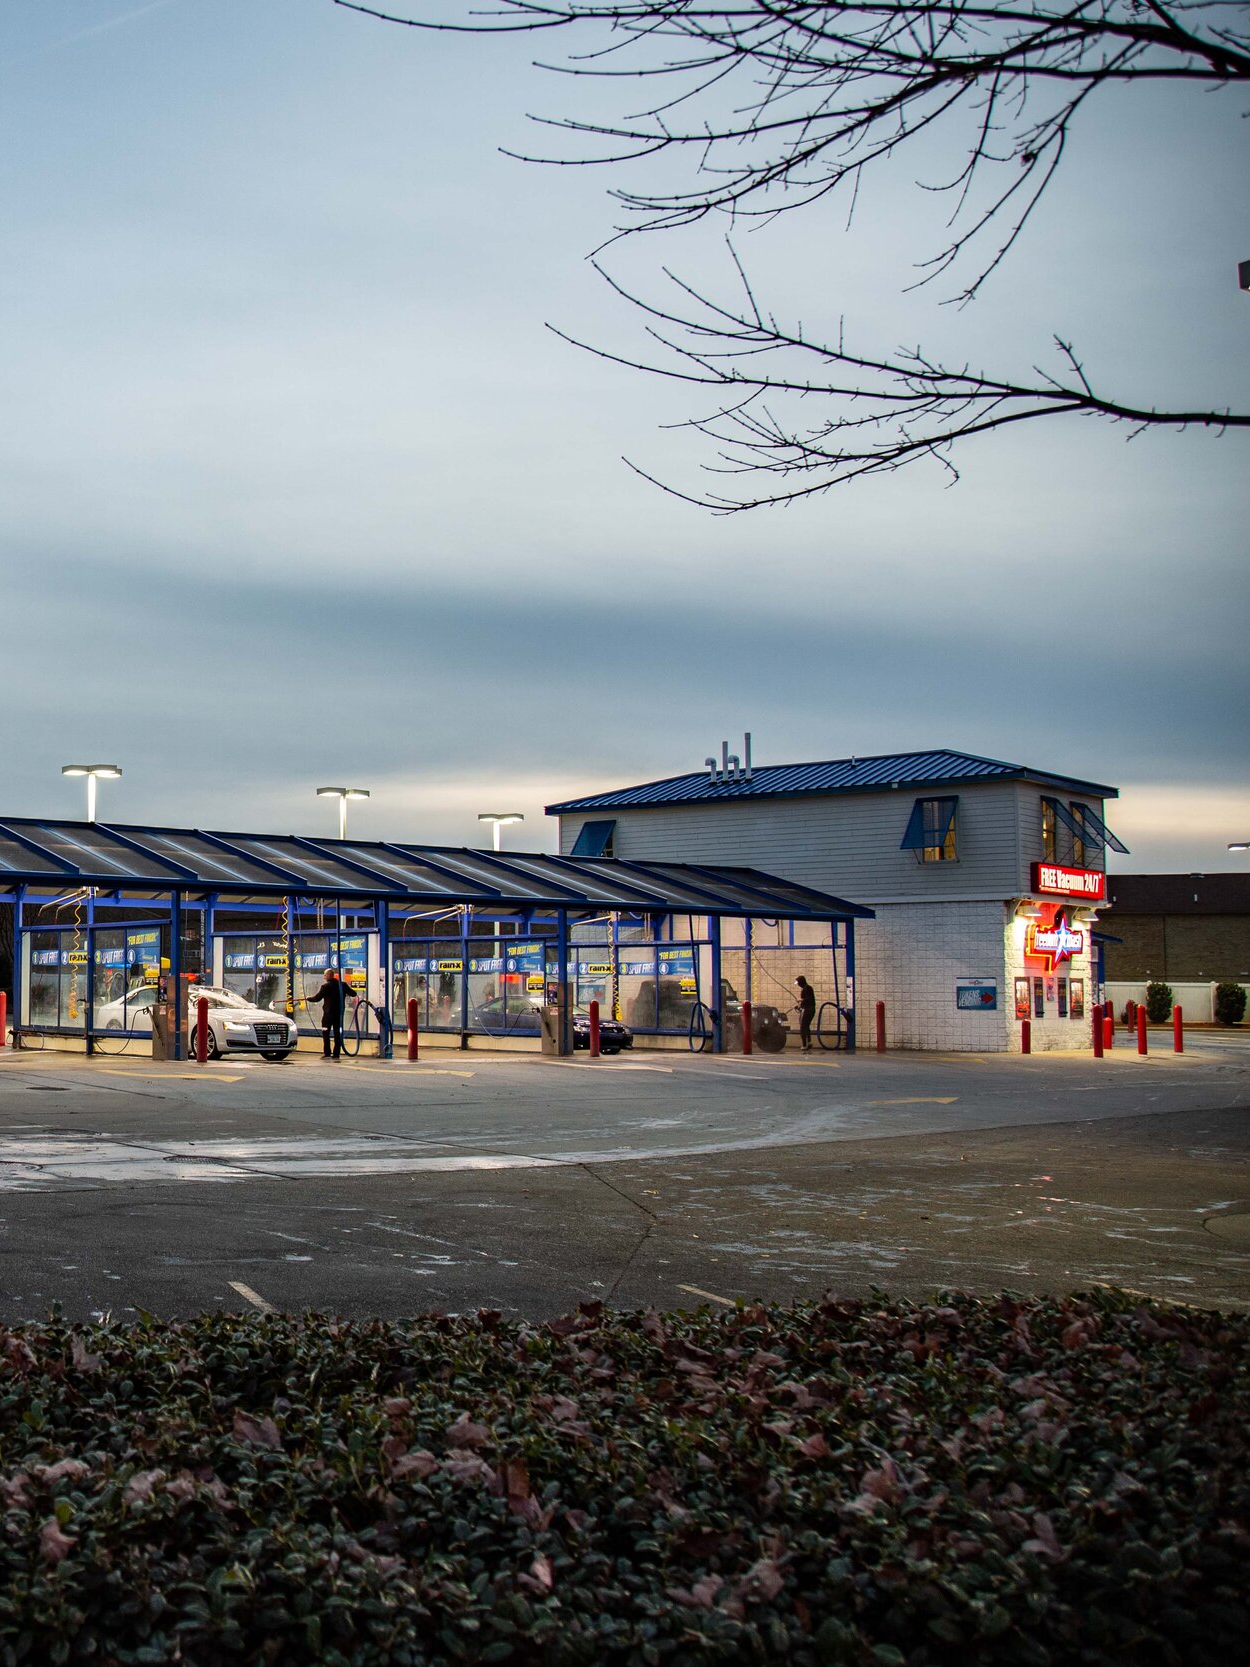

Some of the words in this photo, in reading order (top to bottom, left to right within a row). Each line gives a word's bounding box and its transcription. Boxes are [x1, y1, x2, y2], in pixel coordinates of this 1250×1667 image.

[1041, 868, 1056, 887] FREE
[1057, 870, 1084, 891] Vacuum
[113, 950, 124, 962] FREE
[243, 954, 255, 966] FREE
[302, 956, 315, 968] SPOT
[315, 954, 327, 967] FREE
[415, 959, 426, 970] FREE
[477, 960, 491, 972] SPOT
[491, 959, 504, 970] FREE
[629, 964, 643, 974] SPOT
[642, 963, 654, 973] FREE
